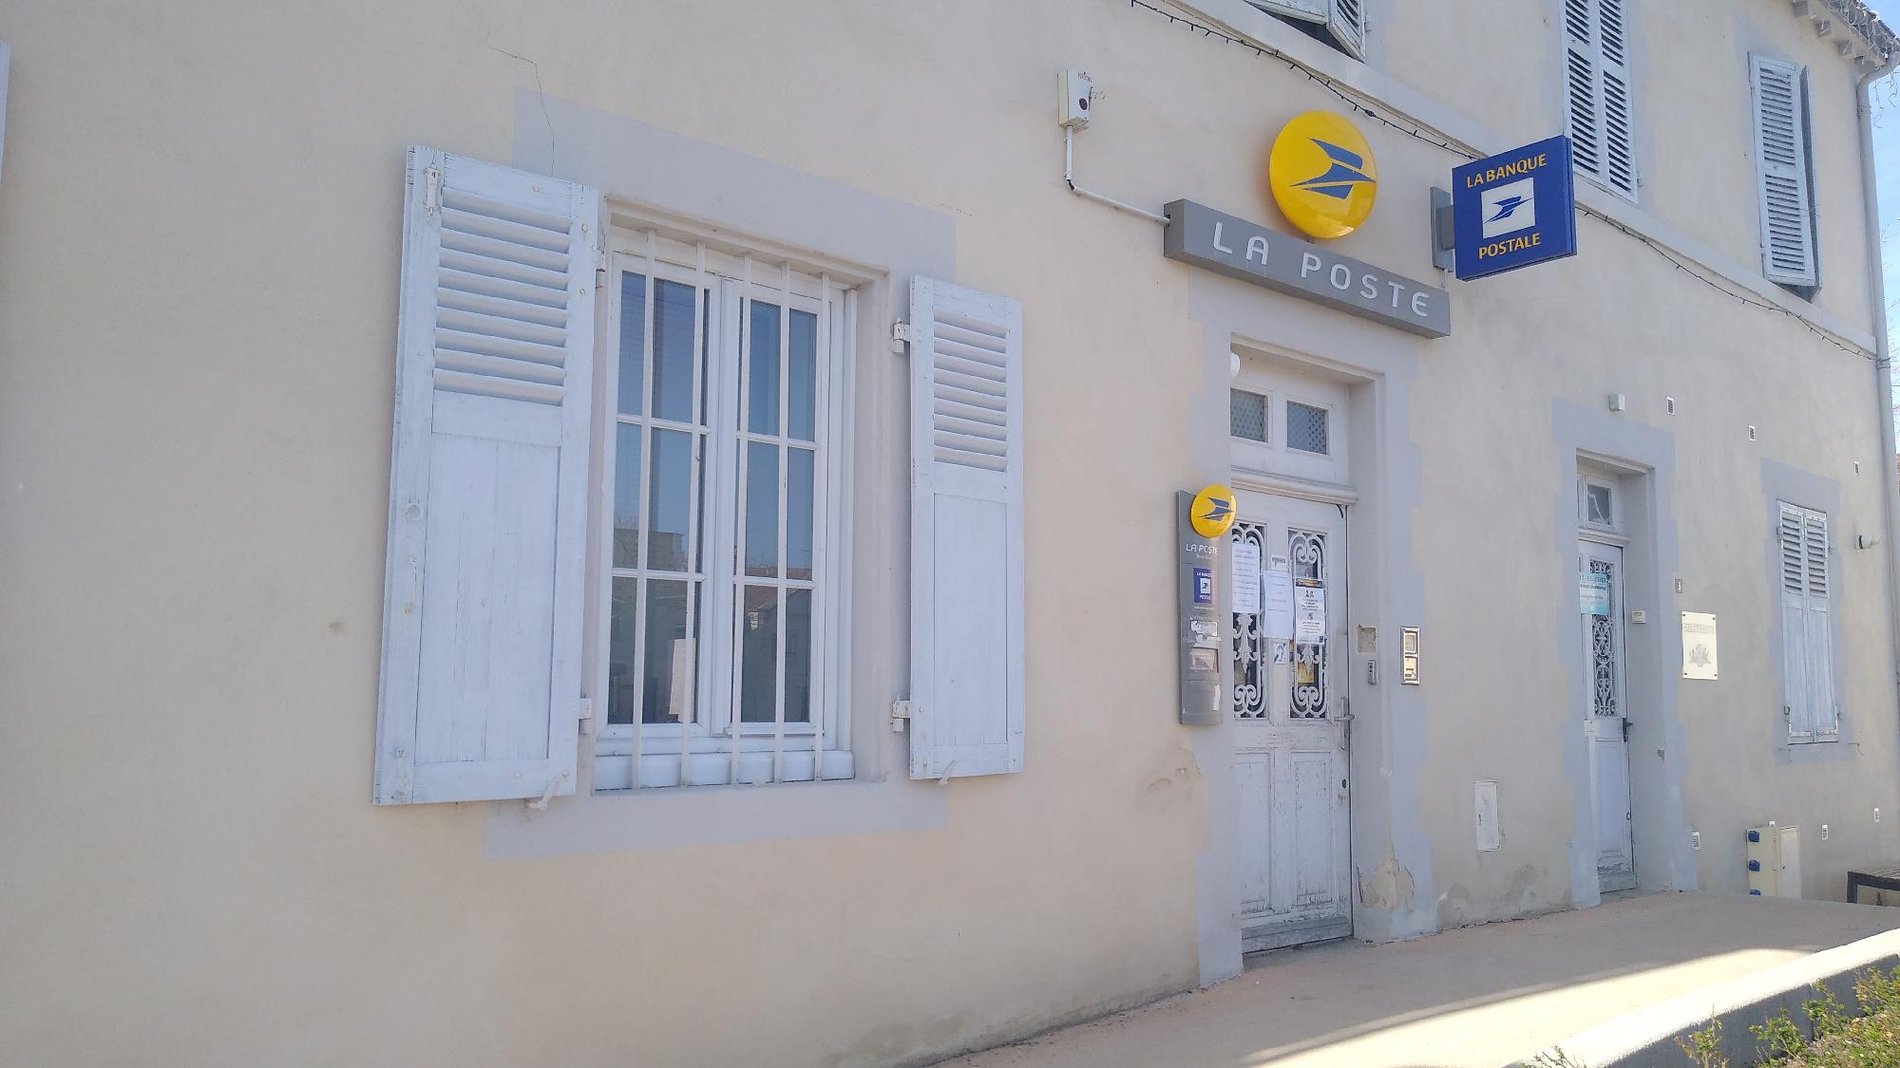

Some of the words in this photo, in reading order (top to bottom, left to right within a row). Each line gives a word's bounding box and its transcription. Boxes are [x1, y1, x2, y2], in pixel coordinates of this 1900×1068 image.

[1467, 173, 1484, 188] LA
[1486, 153, 1547, 182] BANQUE
[1478, 232, 1541, 260] POSTALE
[1212, 221, 1269, 265] LA
[1301, 252, 1430, 317] POSTE
[1185, 543, 1197, 552] LA
